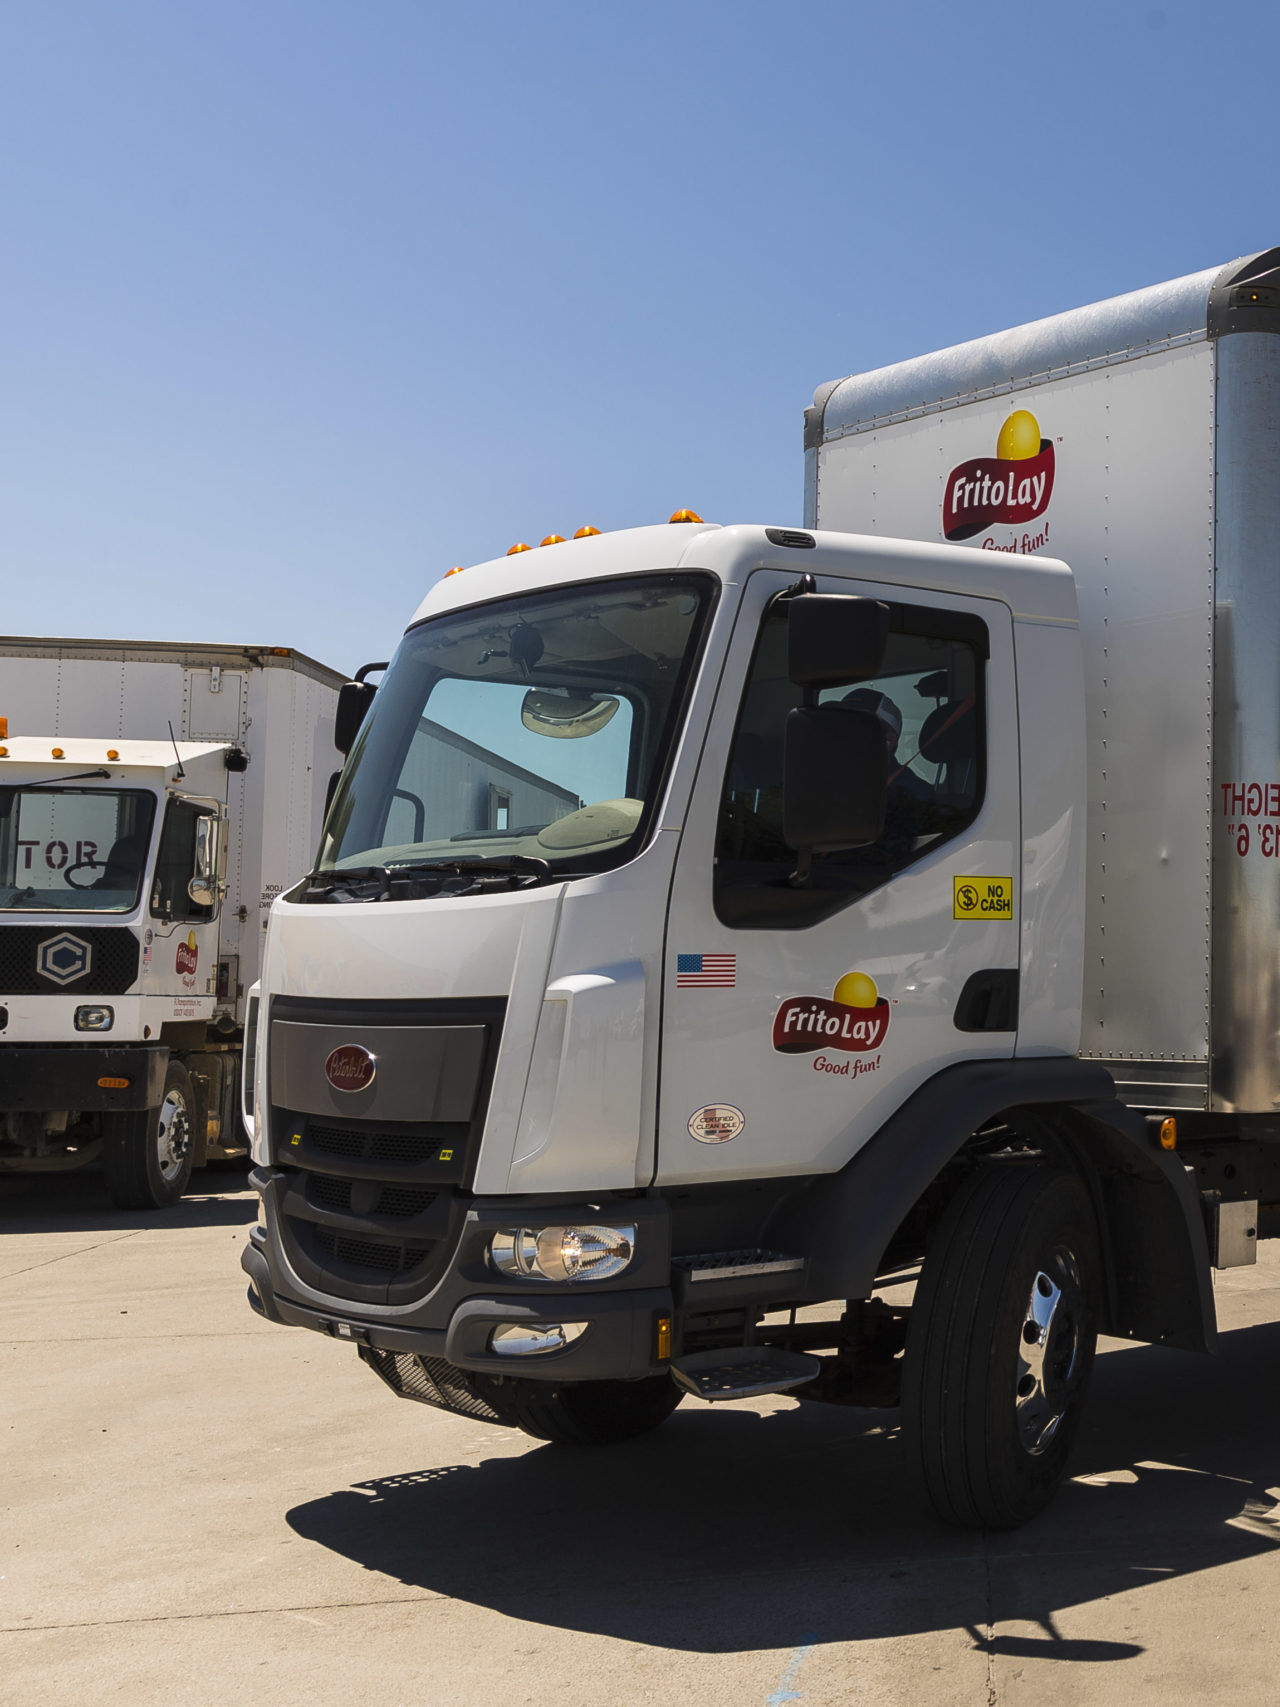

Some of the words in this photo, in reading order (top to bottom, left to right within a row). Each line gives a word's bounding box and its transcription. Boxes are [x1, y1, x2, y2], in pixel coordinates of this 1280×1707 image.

[1020, 521, 1049, 555] fun!
[18, 840, 98, 870] TOR
[987, 884, 1003, 898] NO
[980, 898, 1011, 912] CASH
[813, 1055, 850, 1075] Good
[851, 1054, 881, 1080] fun!
[699, 1115, 735, 1124] CERTIFIED
